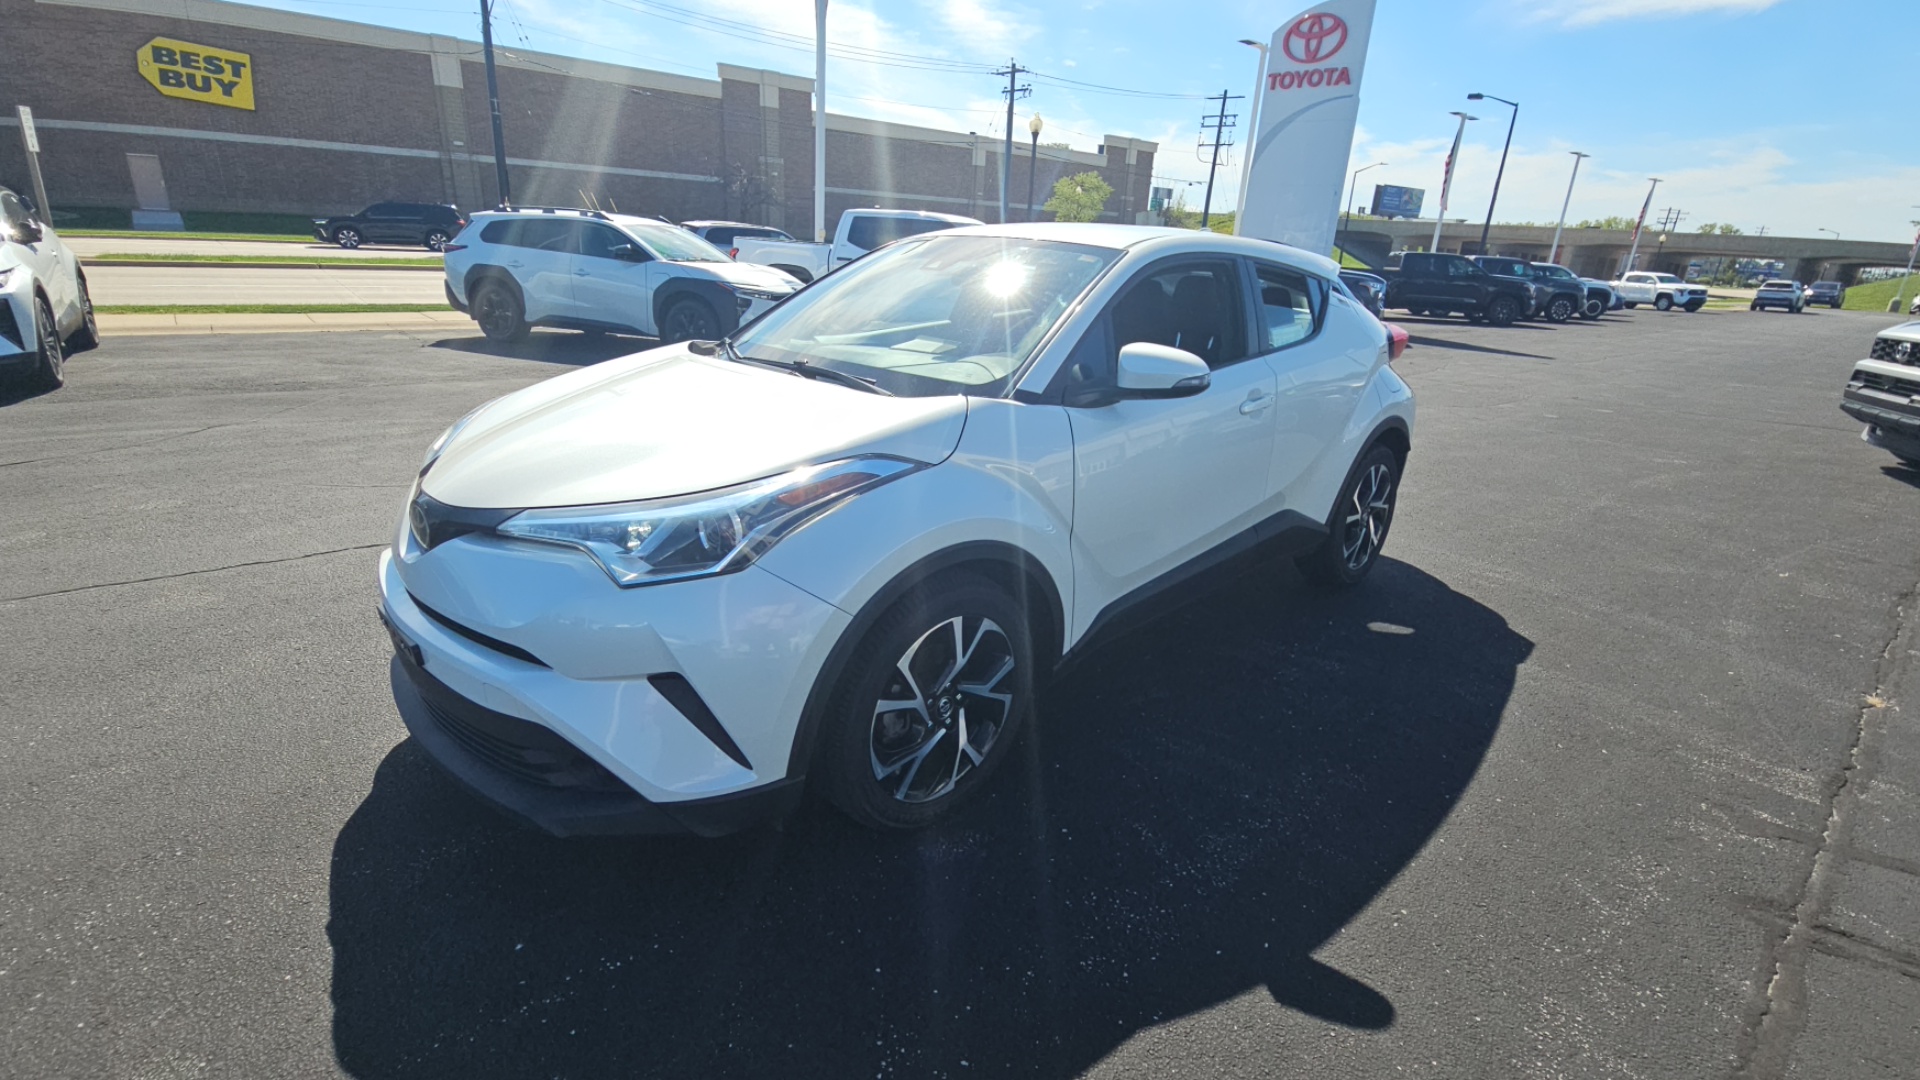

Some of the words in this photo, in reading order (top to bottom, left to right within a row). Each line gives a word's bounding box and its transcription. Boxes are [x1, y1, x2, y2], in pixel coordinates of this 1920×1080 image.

[151, 44, 247, 79] BEST
[158, 67, 240, 98] BUY
[1268, 66, 1351, 91] TOYOTA
